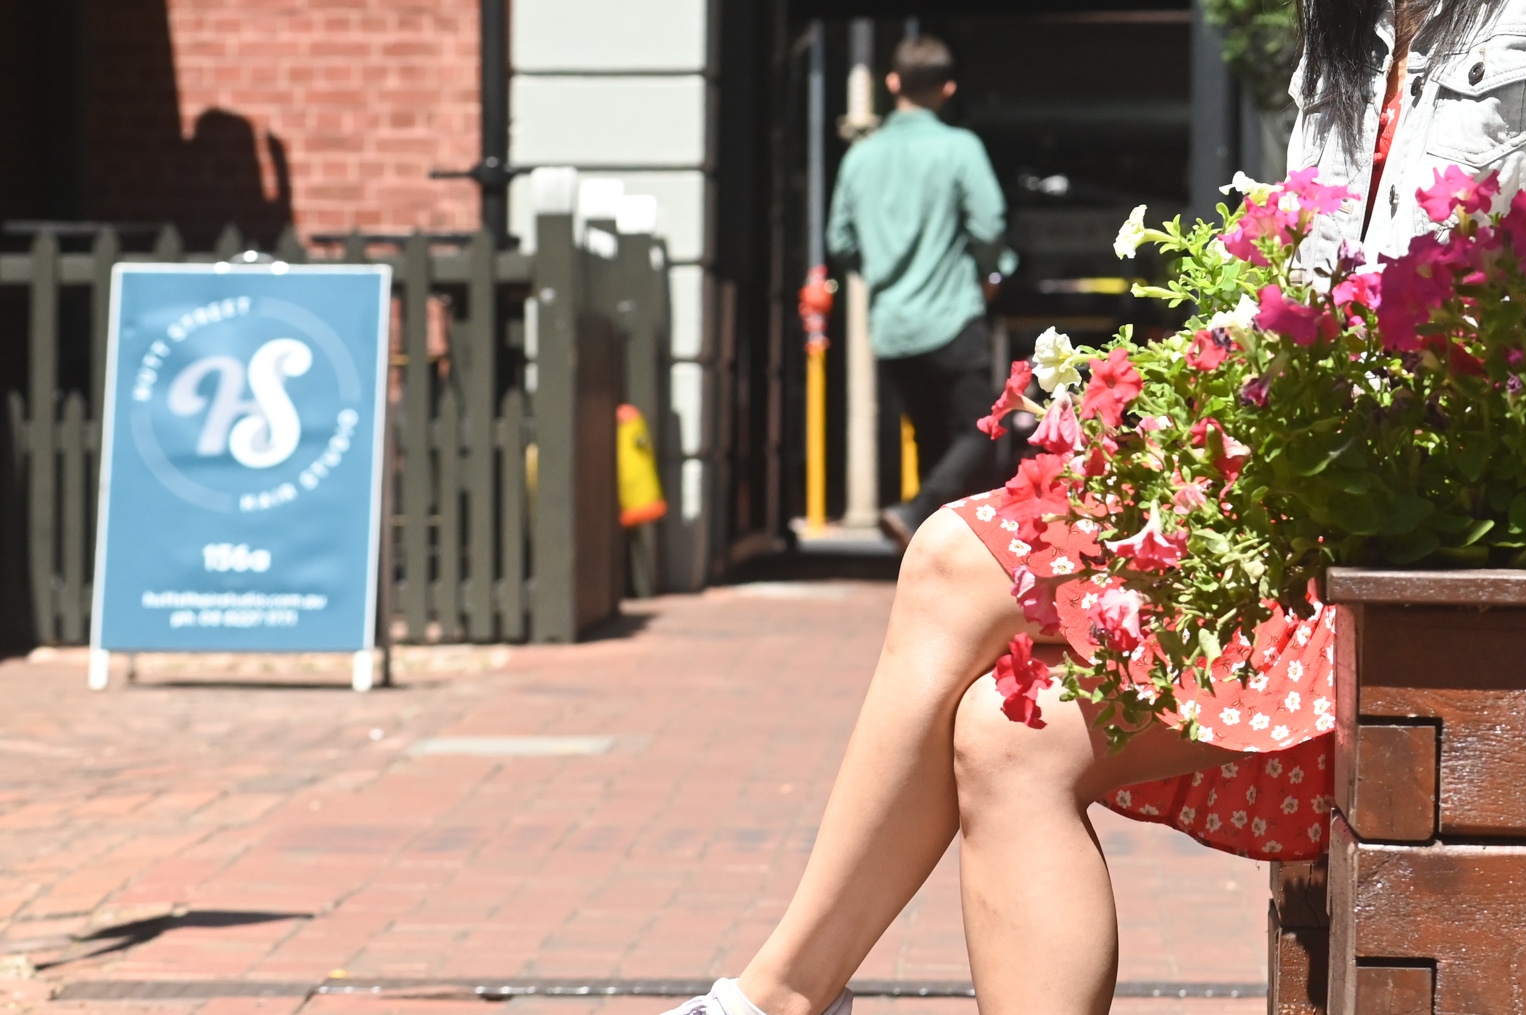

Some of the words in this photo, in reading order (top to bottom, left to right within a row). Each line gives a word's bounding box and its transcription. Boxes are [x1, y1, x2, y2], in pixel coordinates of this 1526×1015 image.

[132, 339, 171, 402] HUTT
[166, 295, 252, 342] STREET
[239, 482, 299, 513] HAIR
[299, 407, 359, 491] STUDIO
